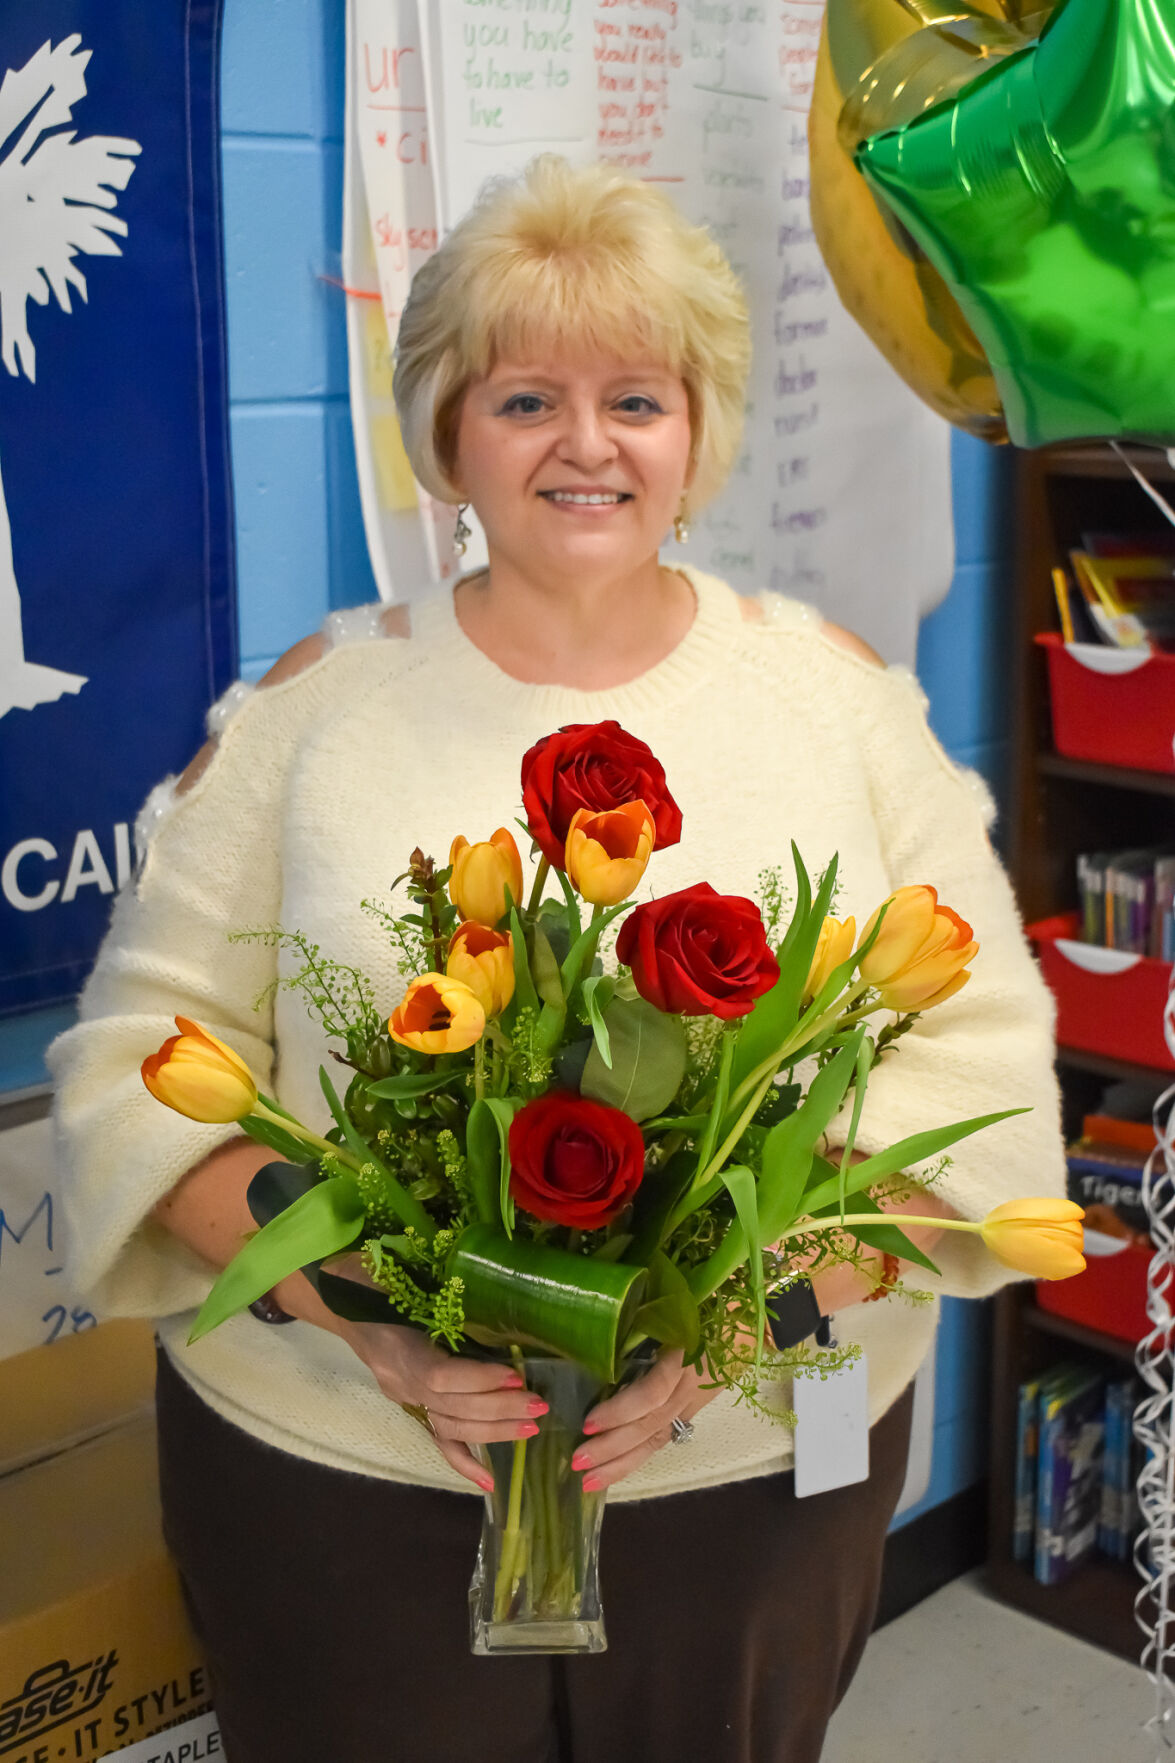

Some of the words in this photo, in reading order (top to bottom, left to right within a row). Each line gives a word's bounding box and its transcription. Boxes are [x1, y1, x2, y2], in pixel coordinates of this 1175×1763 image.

[463, 22, 509, 64] you
[523, 20, 574, 52] have
[542, 59, 570, 88] to
[470, 97, 503, 128] live
[114, 1667, 205, 1738] STYLE
